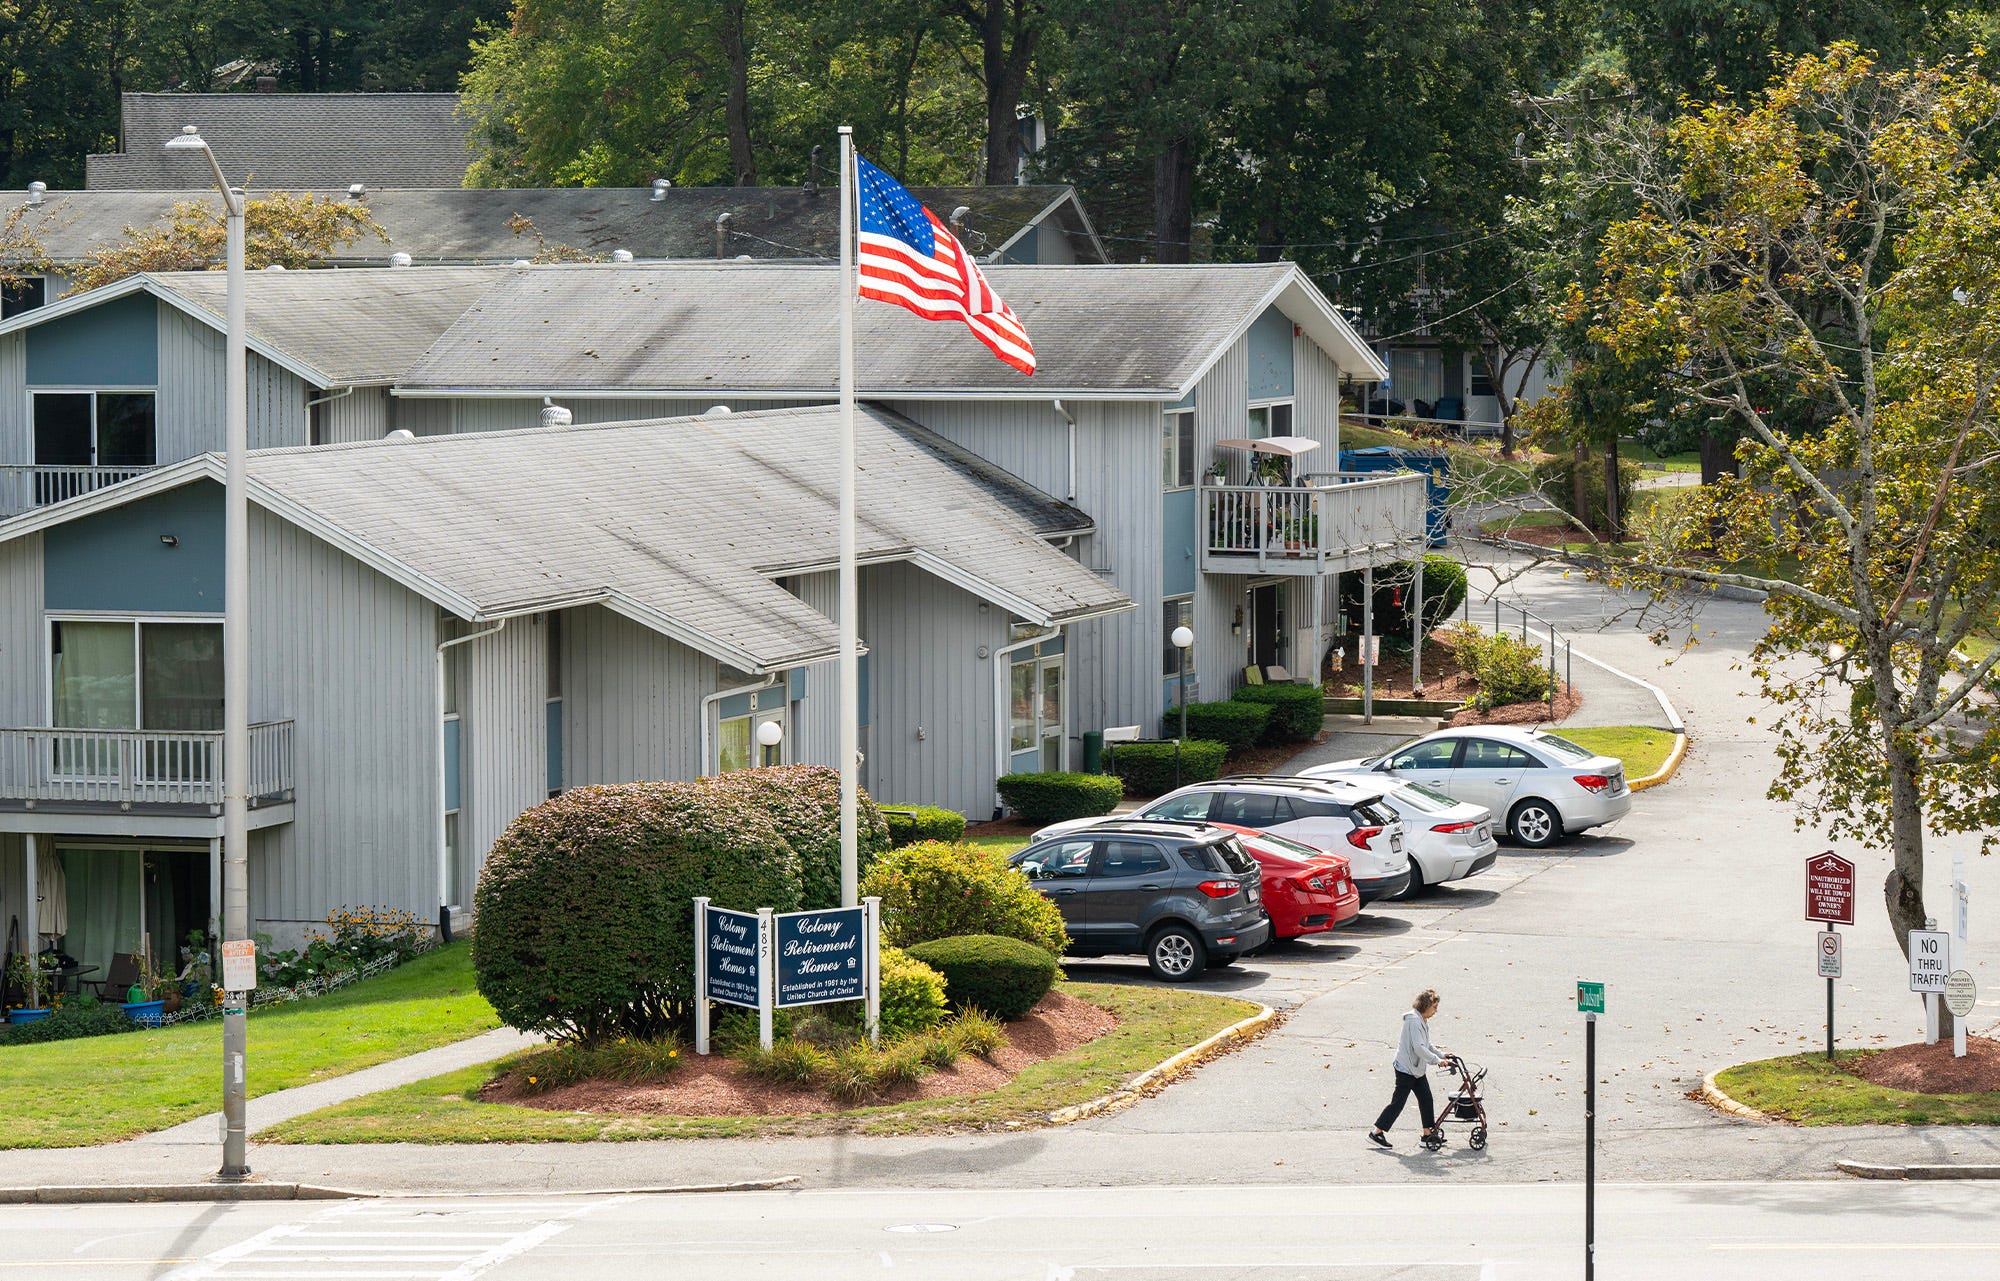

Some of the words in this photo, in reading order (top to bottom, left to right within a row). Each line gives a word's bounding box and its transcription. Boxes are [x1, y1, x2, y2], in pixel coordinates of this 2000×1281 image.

[1810, 875, 1850, 884] UNAUTHORIZED
[719, 915, 748, 940] Colony
[797, 918, 843, 937] Colony
[711, 935, 755, 956] Retirement
[784, 935, 856, 956] Retirement
[1922, 939, 1938, 953] NO
[720, 956, 747, 974] Homes
[798, 958, 842, 974] Homes
[1918, 958, 1941, 970] THRU
[710, 977, 731, 987] Established
[746, 983, 750, 992] by
[782, 981, 815, 992] Established
[840, 978, 847, 986] by
[1912, 973, 1948, 984] TRAFFIC
[712, 987, 724, 995] United
[725, 988, 738, 998] Church
[744, 993, 754, 1001] Christ
[787, 992, 805, 1000] United
[807, 990, 827, 998] Church
